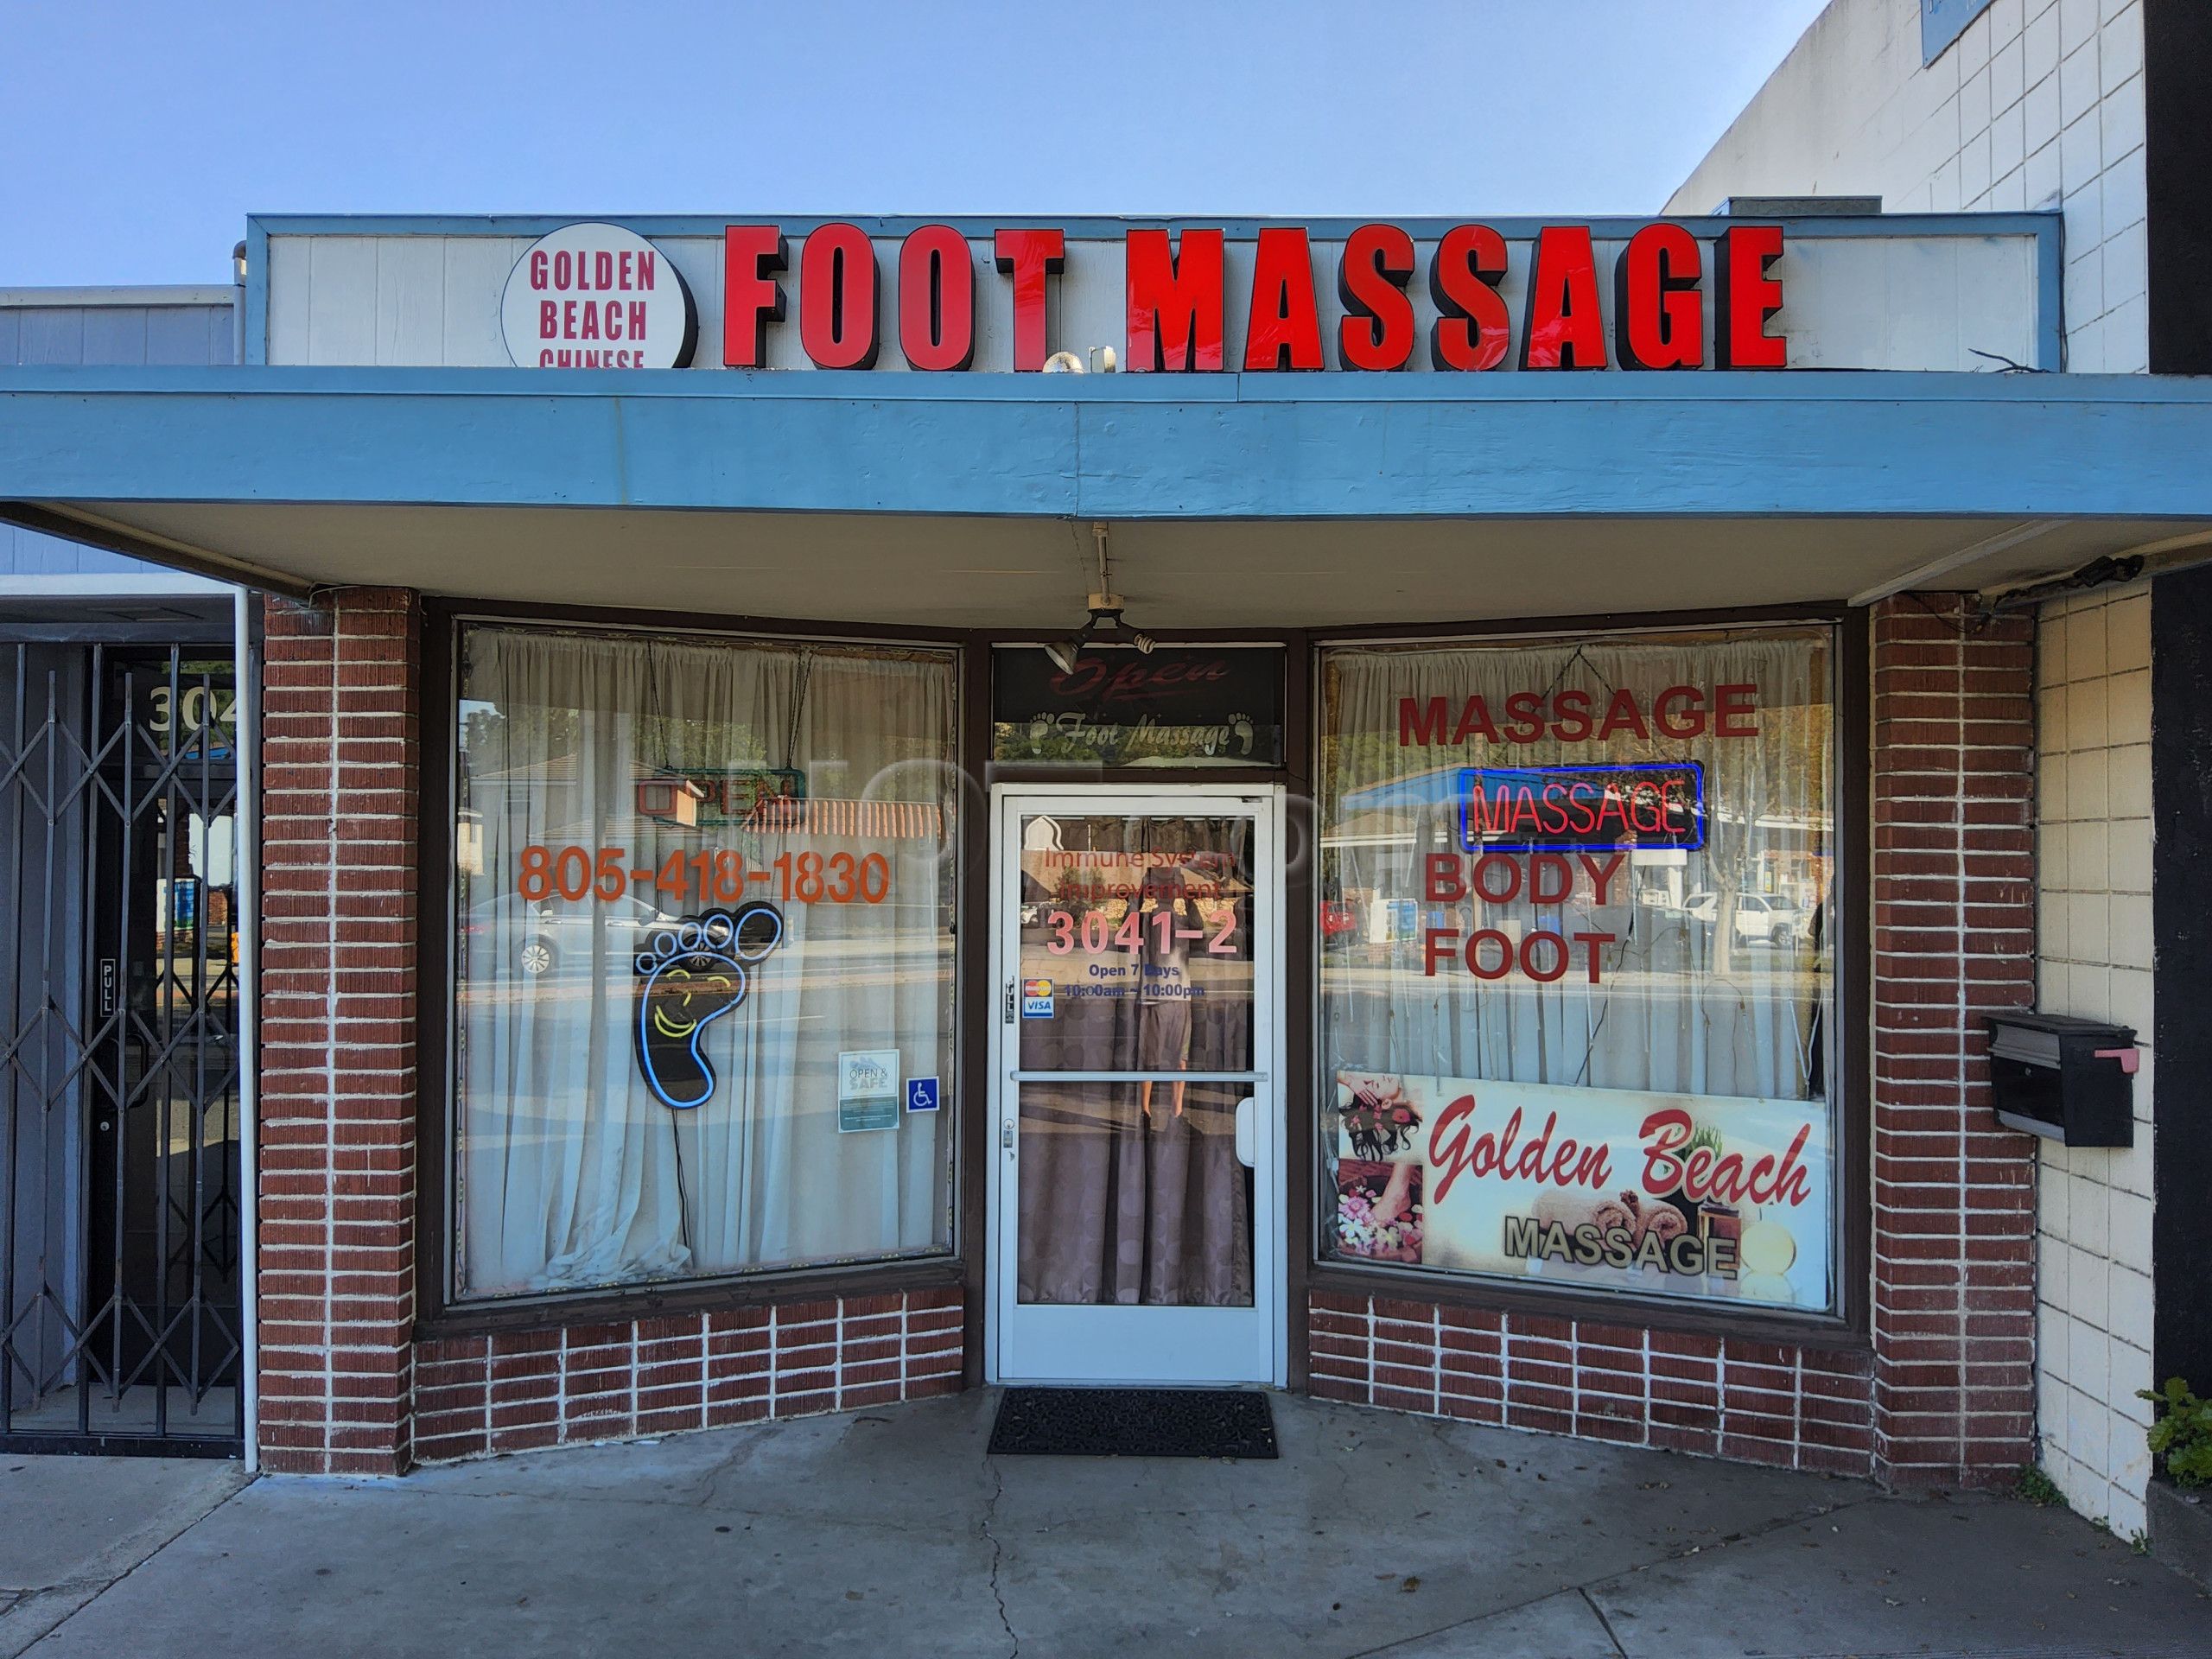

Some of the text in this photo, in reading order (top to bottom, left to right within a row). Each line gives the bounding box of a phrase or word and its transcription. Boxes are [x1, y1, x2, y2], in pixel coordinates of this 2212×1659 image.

[531, 251, 655, 290] GOLDEN
[723, 222, 1787, 371] FOOT MASSAGE
[540, 300, 646, 340] BEACH
[1050, 657, 1230, 702] Open
[1056, 712, 1230, 756] Foot Massage
[1399, 683, 1758, 747] MASSAGE
[638, 779, 792, 815] OPEN
[1472, 777, 1686, 835] MASSAGE
[520, 845, 890, 904] 805-418-1830
[1046, 847, 1144, 868] Immune
[1426, 852, 1624, 906] BODY
[1046, 910, 1238, 956] 3041-2
[1425, 927, 1616, 984] FOOT
[103, 964, 111, 1013] PULL
[1064, 983, 1125, 997] 10:00am
[1143, 983, 1205, 999] 10:00pm
[1089, 963, 1180, 979] Open 7 Days
[1027, 1001, 1051, 1010] VISA
[849, 1068, 878, 1078] OPEN
[1428, 1094, 1812, 1207] Golden Beach
[1503, 1215, 1740, 1281] MASSAGE
